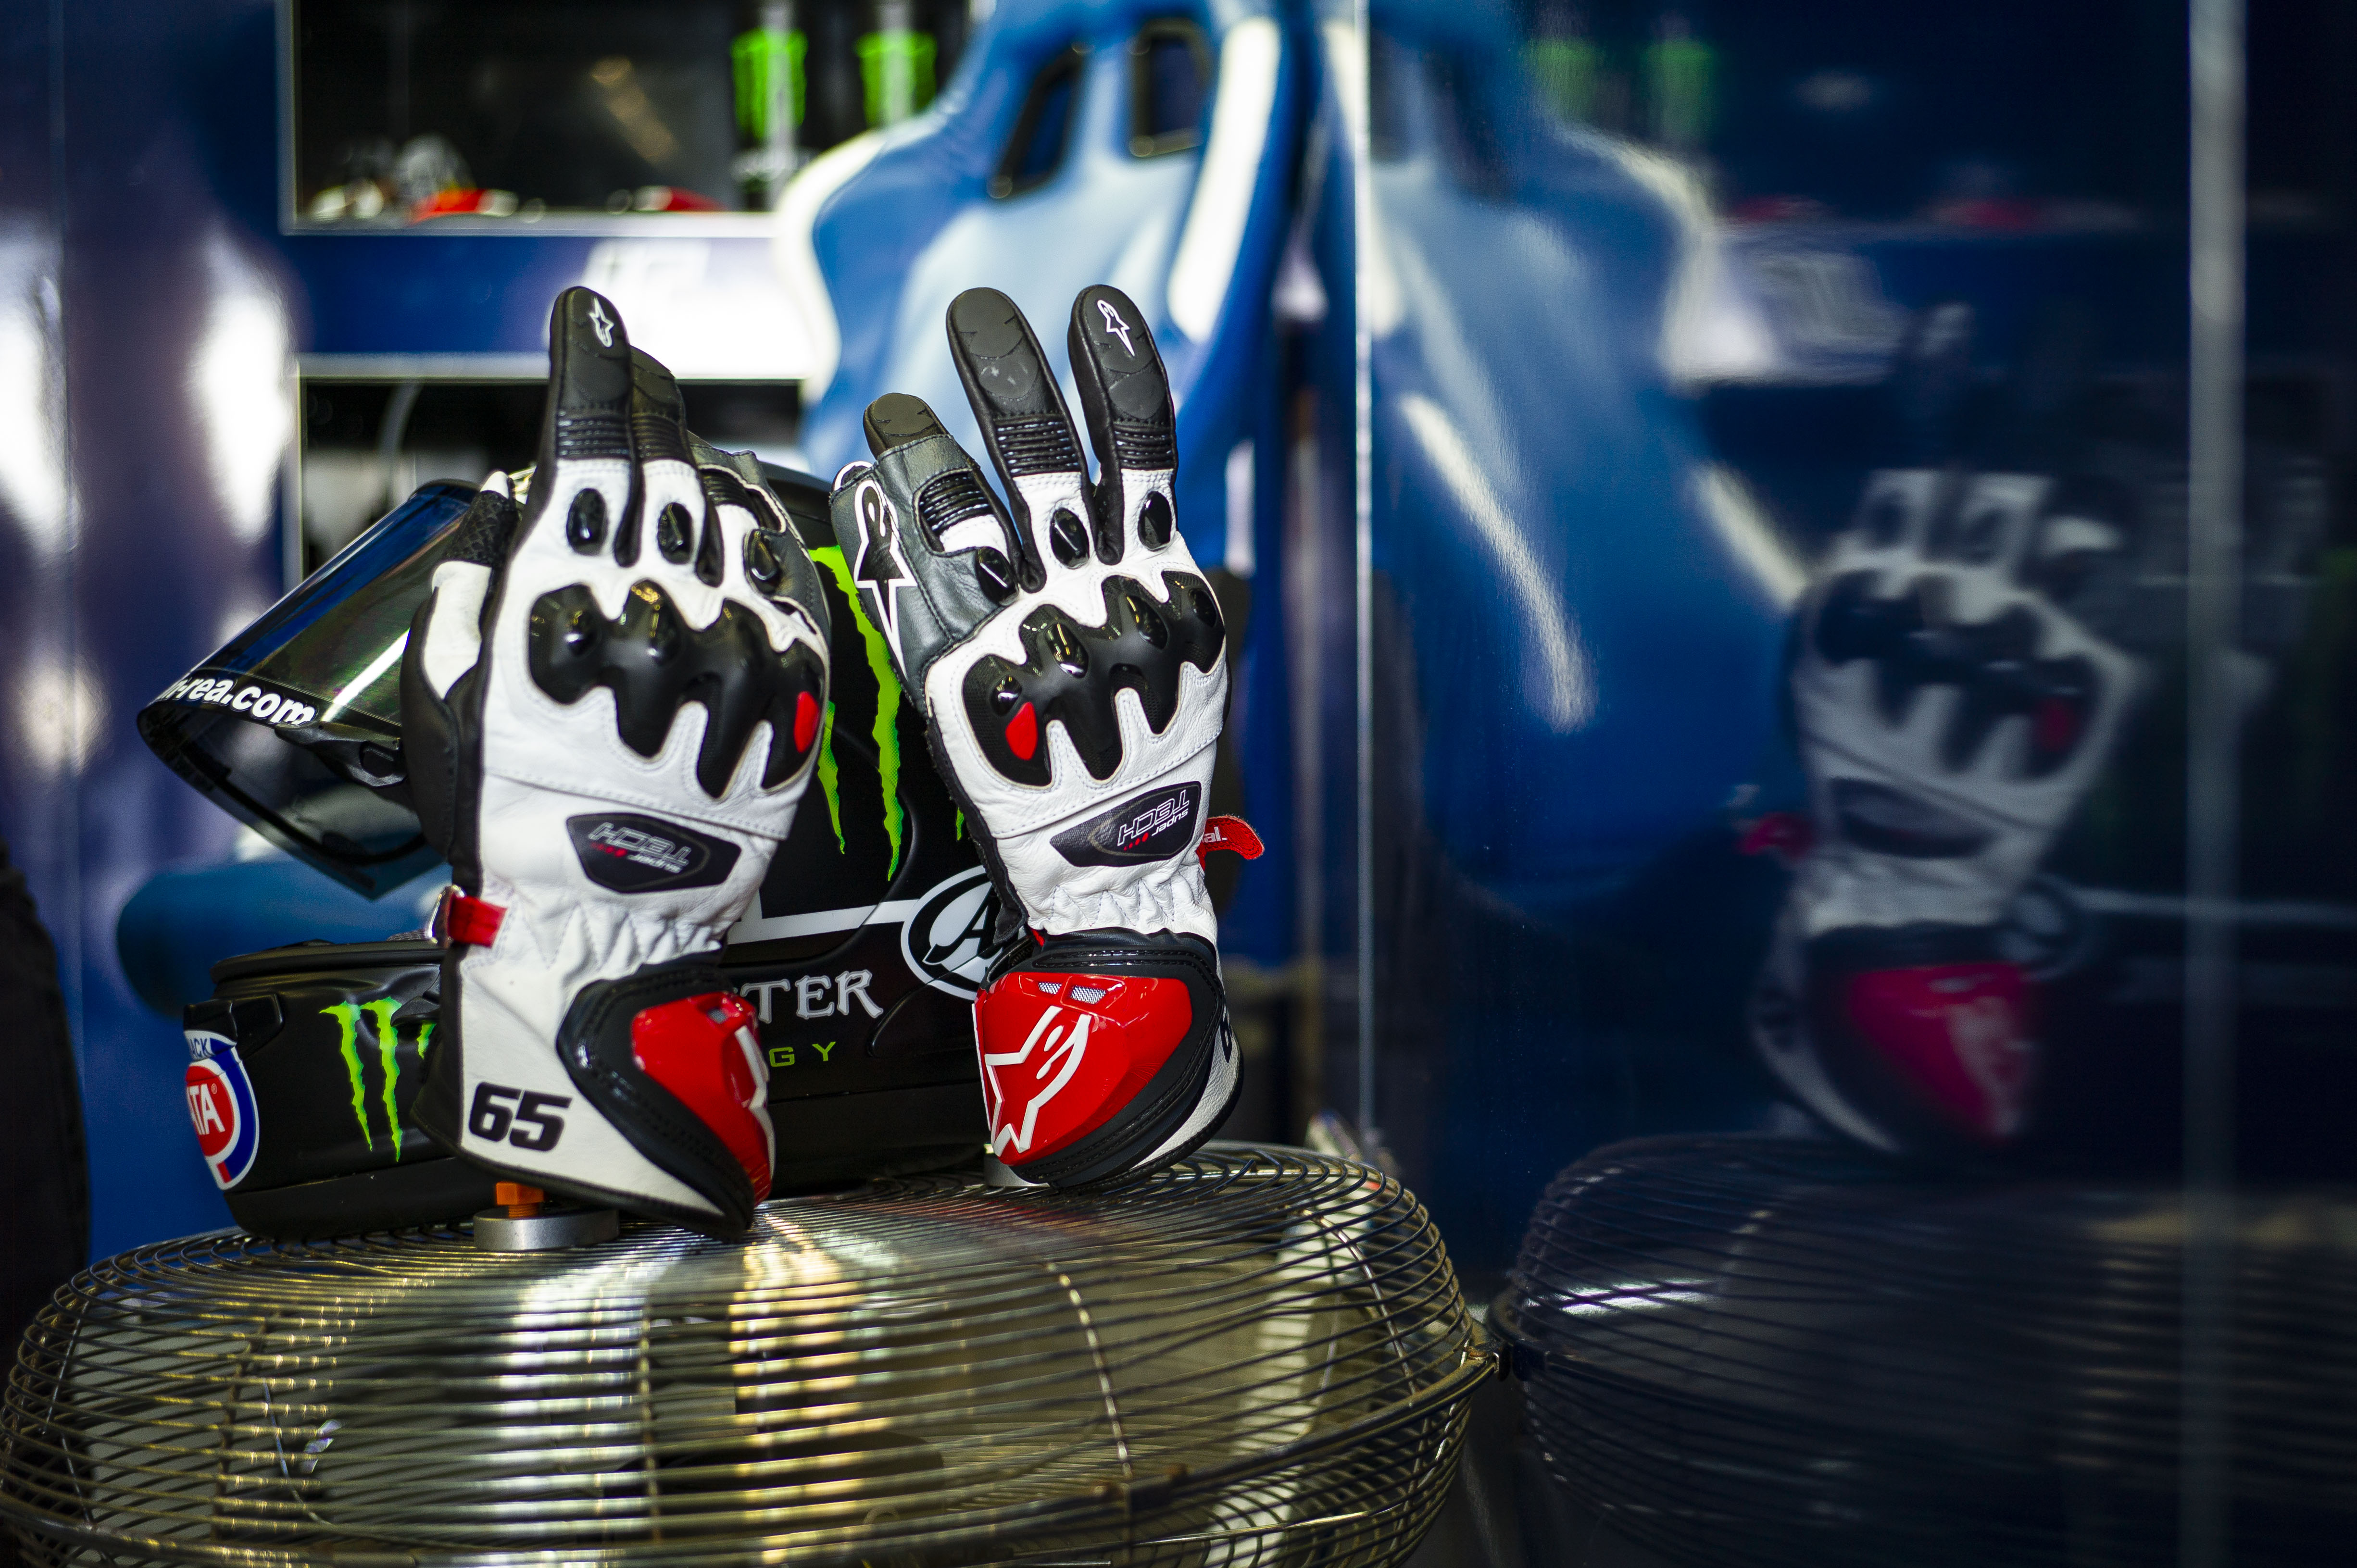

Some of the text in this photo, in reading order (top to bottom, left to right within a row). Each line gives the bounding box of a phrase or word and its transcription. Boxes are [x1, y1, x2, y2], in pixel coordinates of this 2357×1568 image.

[588, 822, 692, 867] TECH
[1117, 790, 1190, 846] TECH
[469, 1082, 573, 1152] 65
